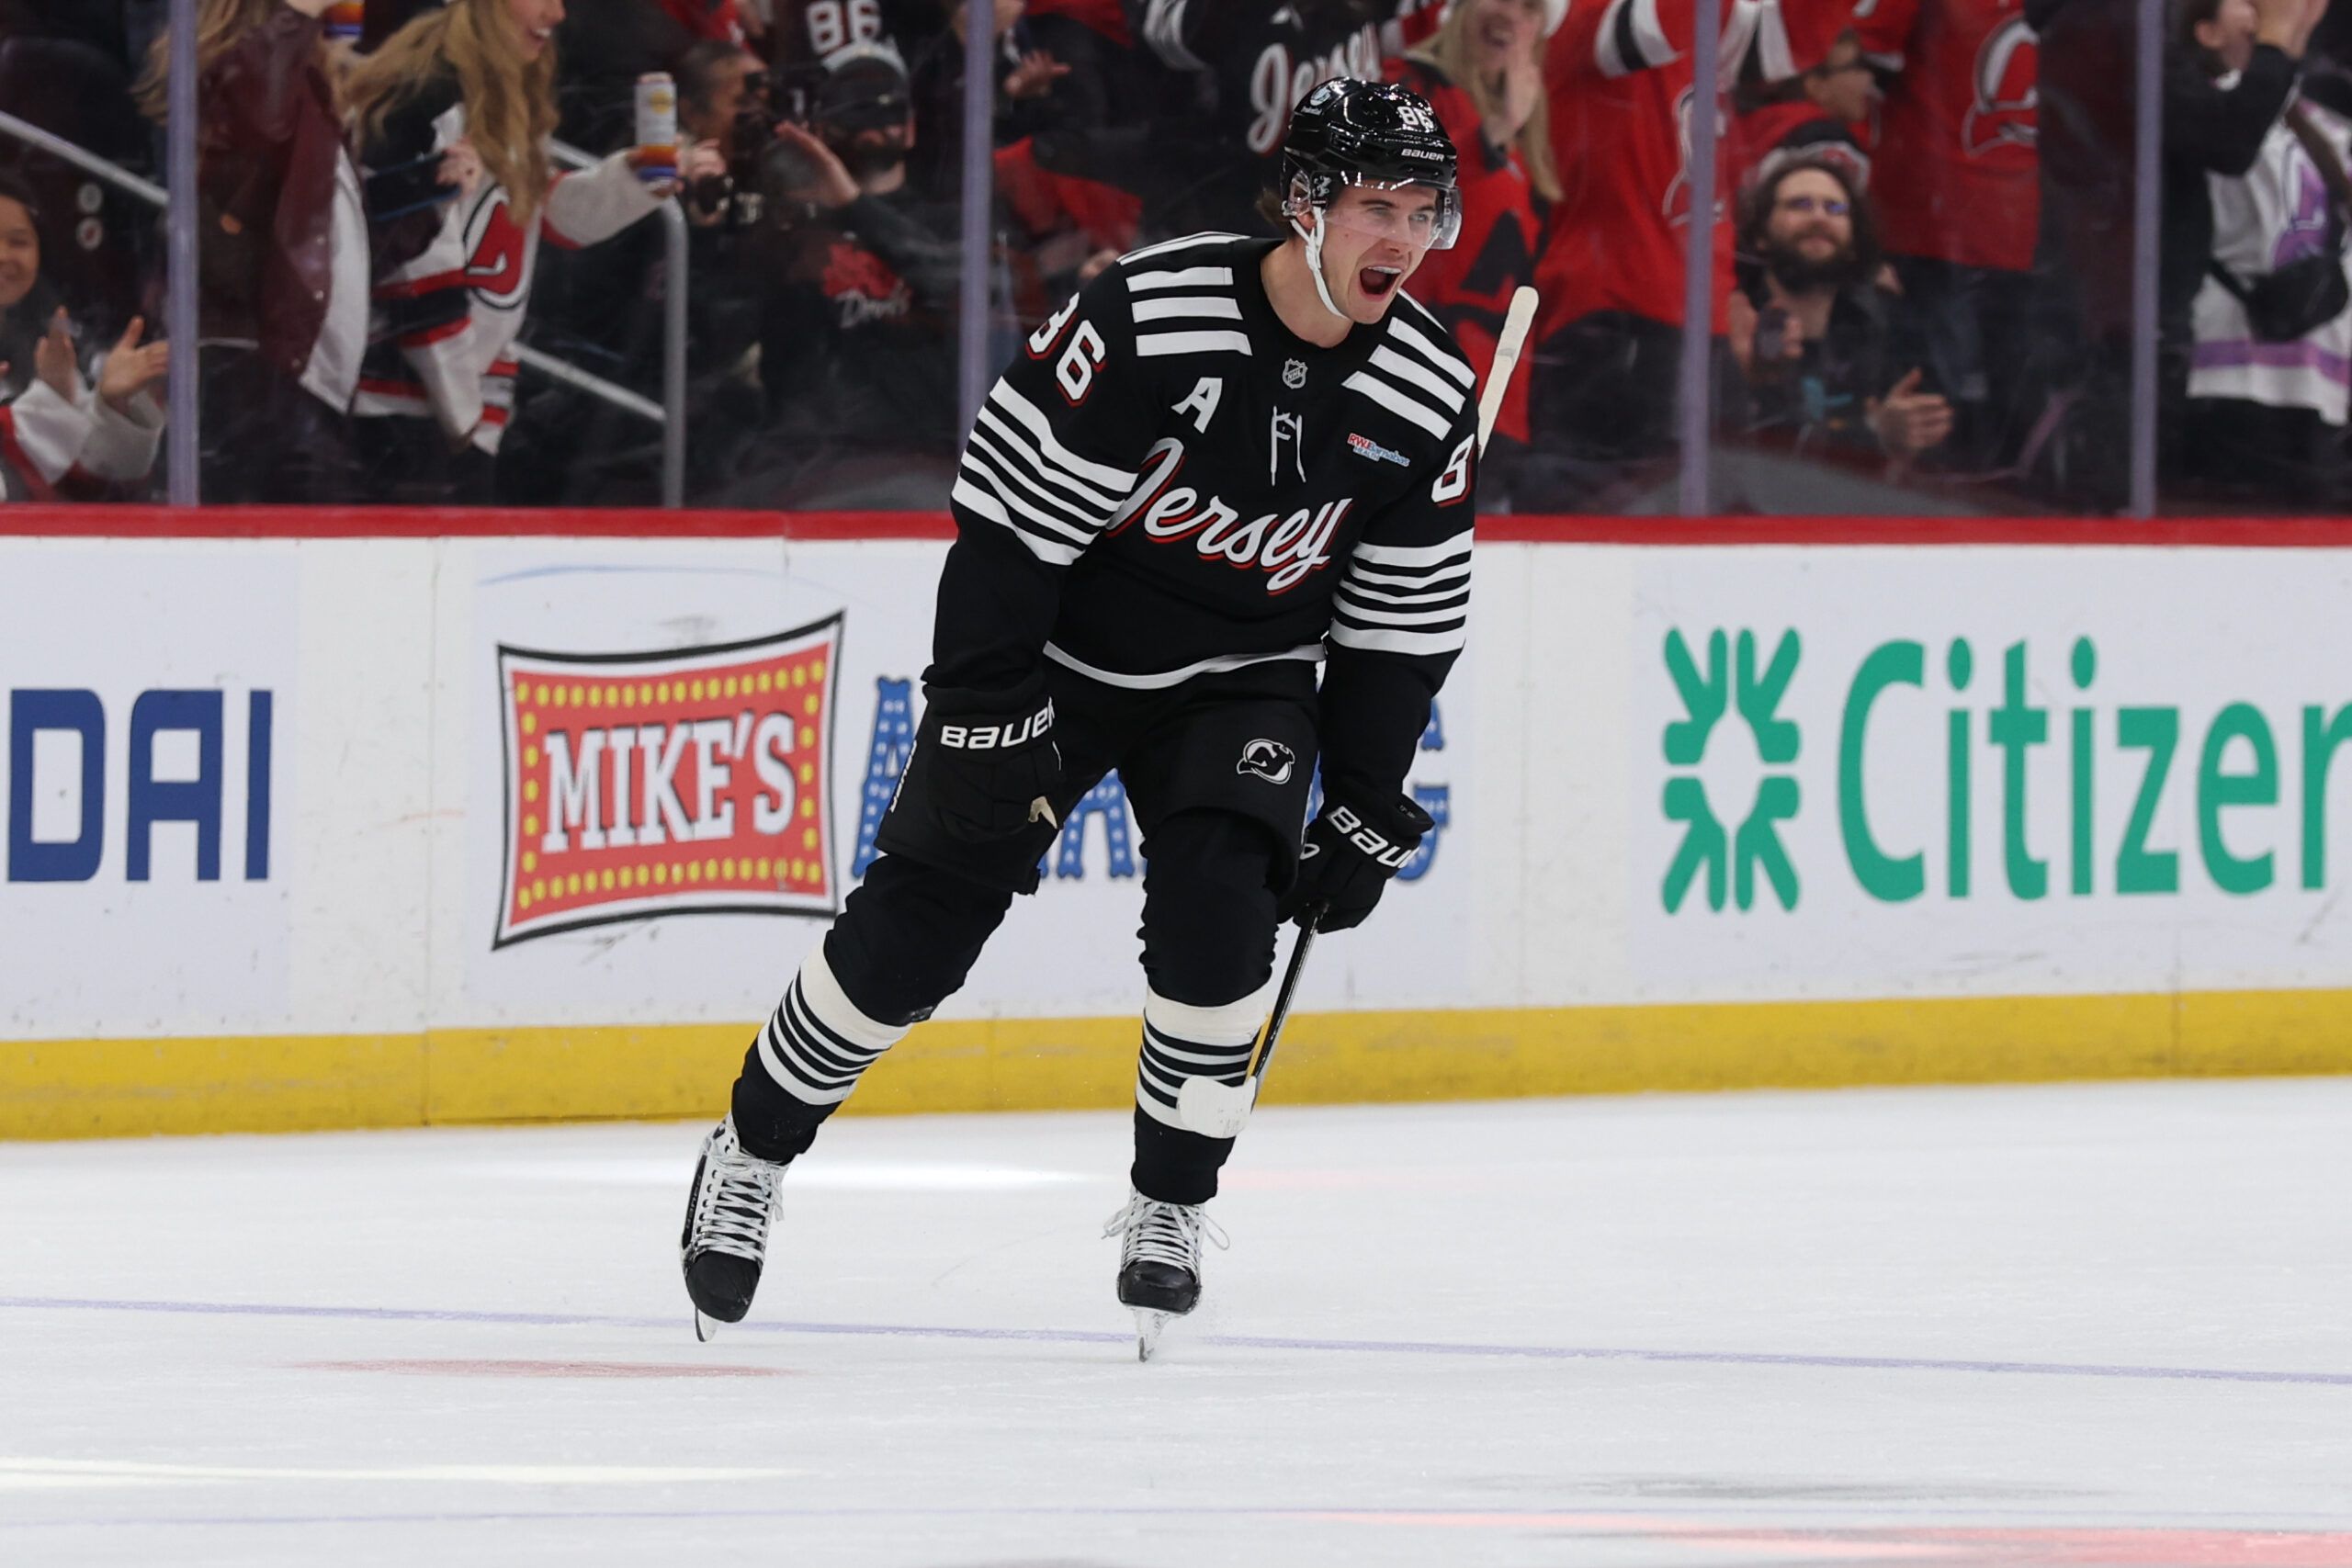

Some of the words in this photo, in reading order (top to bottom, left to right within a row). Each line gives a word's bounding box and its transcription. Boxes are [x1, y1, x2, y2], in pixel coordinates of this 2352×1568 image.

[1396, 106, 1435, 129] 86
[1170, 377, 1223, 434] A
[1105, 436, 1353, 596] Jersey
[6, 689, 273, 882] DAI
[540, 708, 797, 854] MIKE'S
[1326, 805, 1420, 869] BAU
